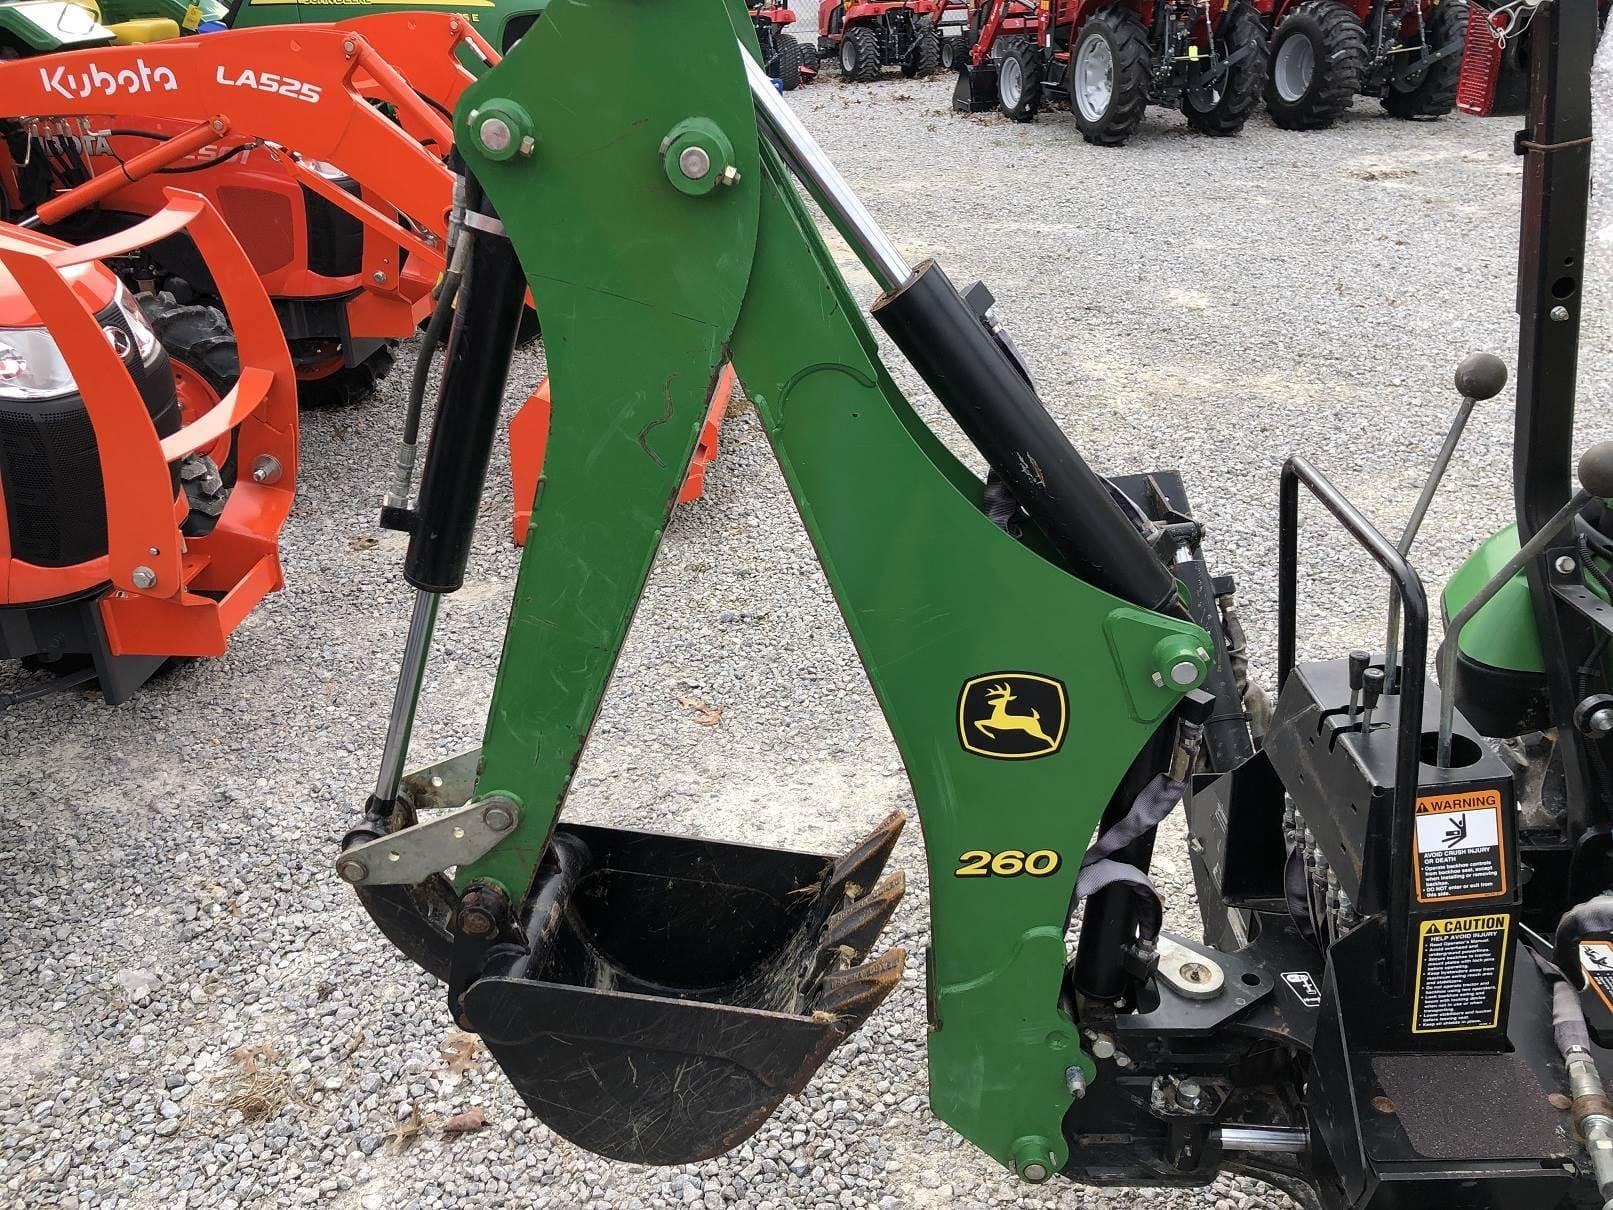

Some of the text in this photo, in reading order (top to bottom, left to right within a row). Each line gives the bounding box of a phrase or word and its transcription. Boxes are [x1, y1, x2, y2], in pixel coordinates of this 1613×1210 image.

[39, 58, 179, 99] Kubota
[216, 65, 322, 104] LA525
[1431, 796, 1496, 811] WARNING
[955, 849, 1061, 878] 260
[1444, 917, 1504, 932] CAUTION
